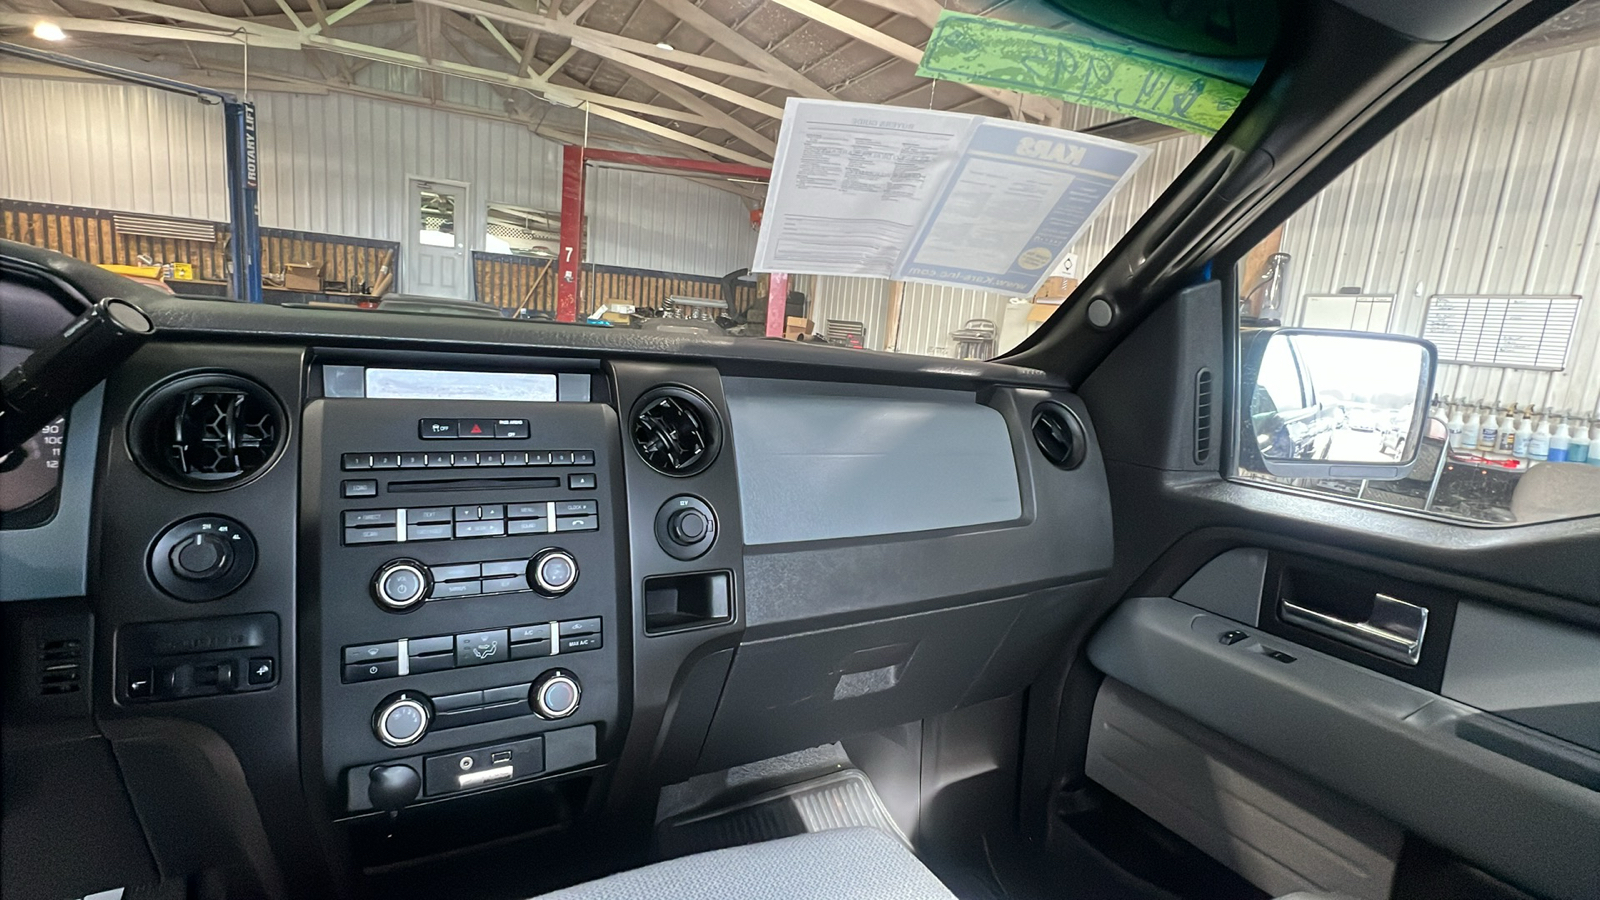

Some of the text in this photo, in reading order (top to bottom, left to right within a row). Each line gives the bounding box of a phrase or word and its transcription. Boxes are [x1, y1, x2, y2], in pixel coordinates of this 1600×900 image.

[245, 104, 257, 181] ROTARY LIFT
[565, 246, 573, 263] 7
[42, 425, 59, 434] 90
